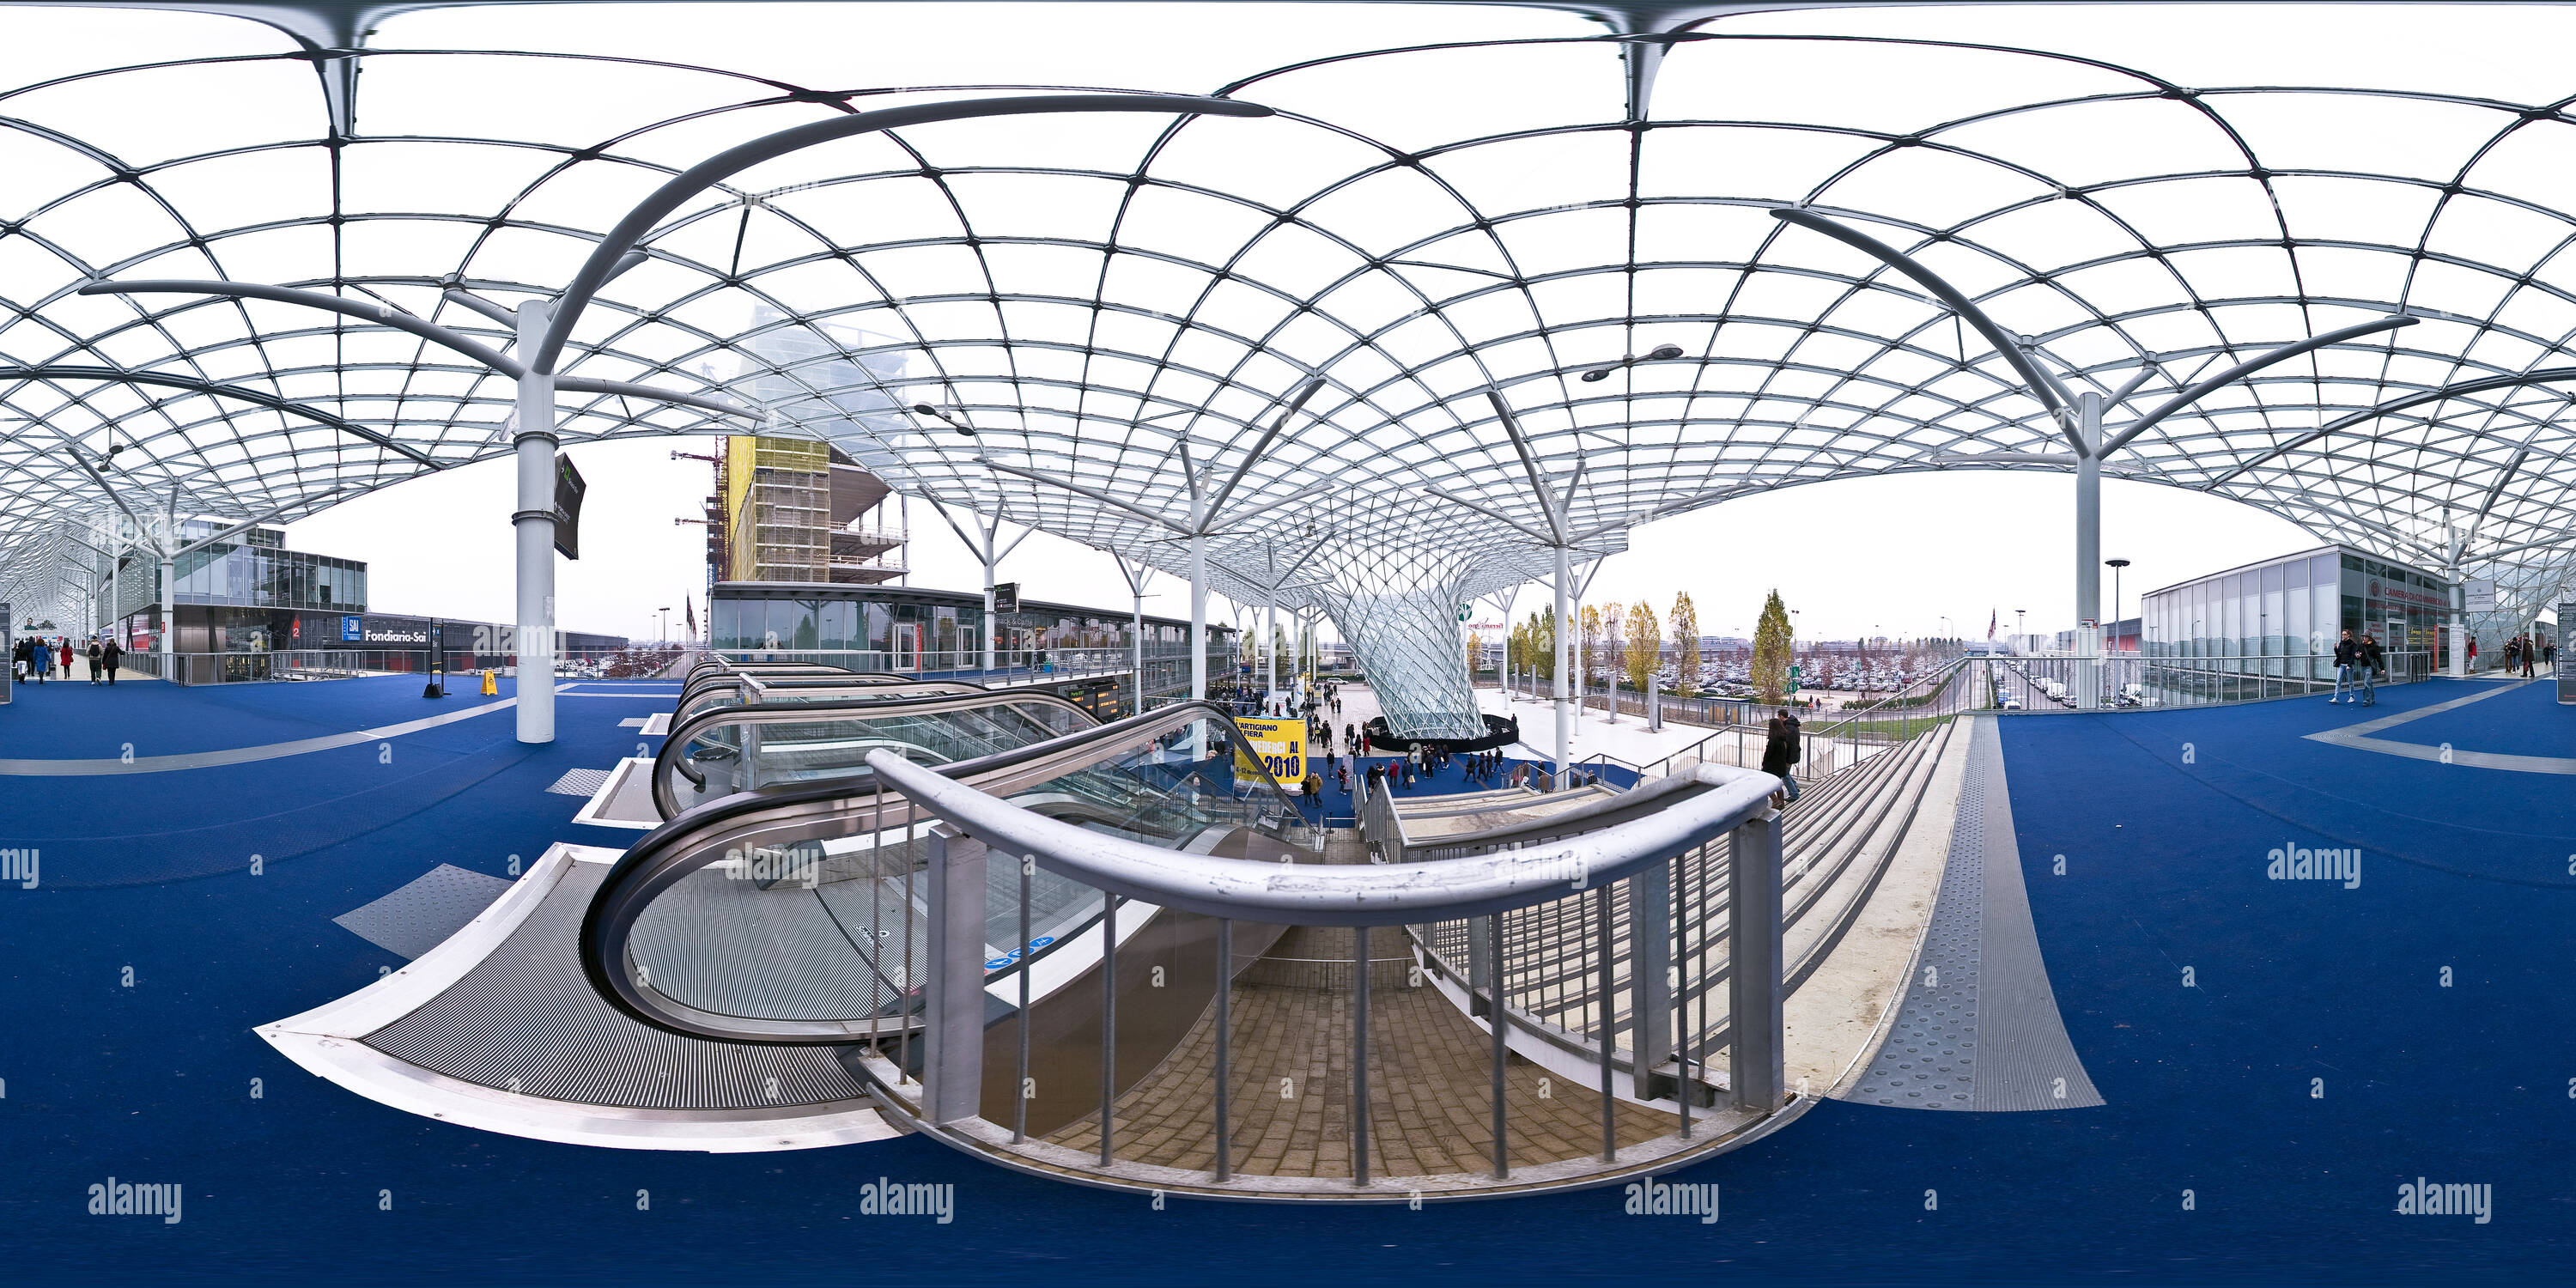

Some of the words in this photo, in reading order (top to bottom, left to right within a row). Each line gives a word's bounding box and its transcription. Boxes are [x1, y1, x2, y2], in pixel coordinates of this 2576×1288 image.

[2385, 586, 2408, 599] CAMERA
[2409, 592, 2415, 601] DI
[293, 628, 300, 637] 2
[349, 619, 359, 632] SAI
[365, 629, 427, 642] Fondiaria-Sai
[1249, 739, 1285, 754] VEDERCI
[1290, 741, 1298, 754] AL
[1264, 755, 1299, 778] 2010
